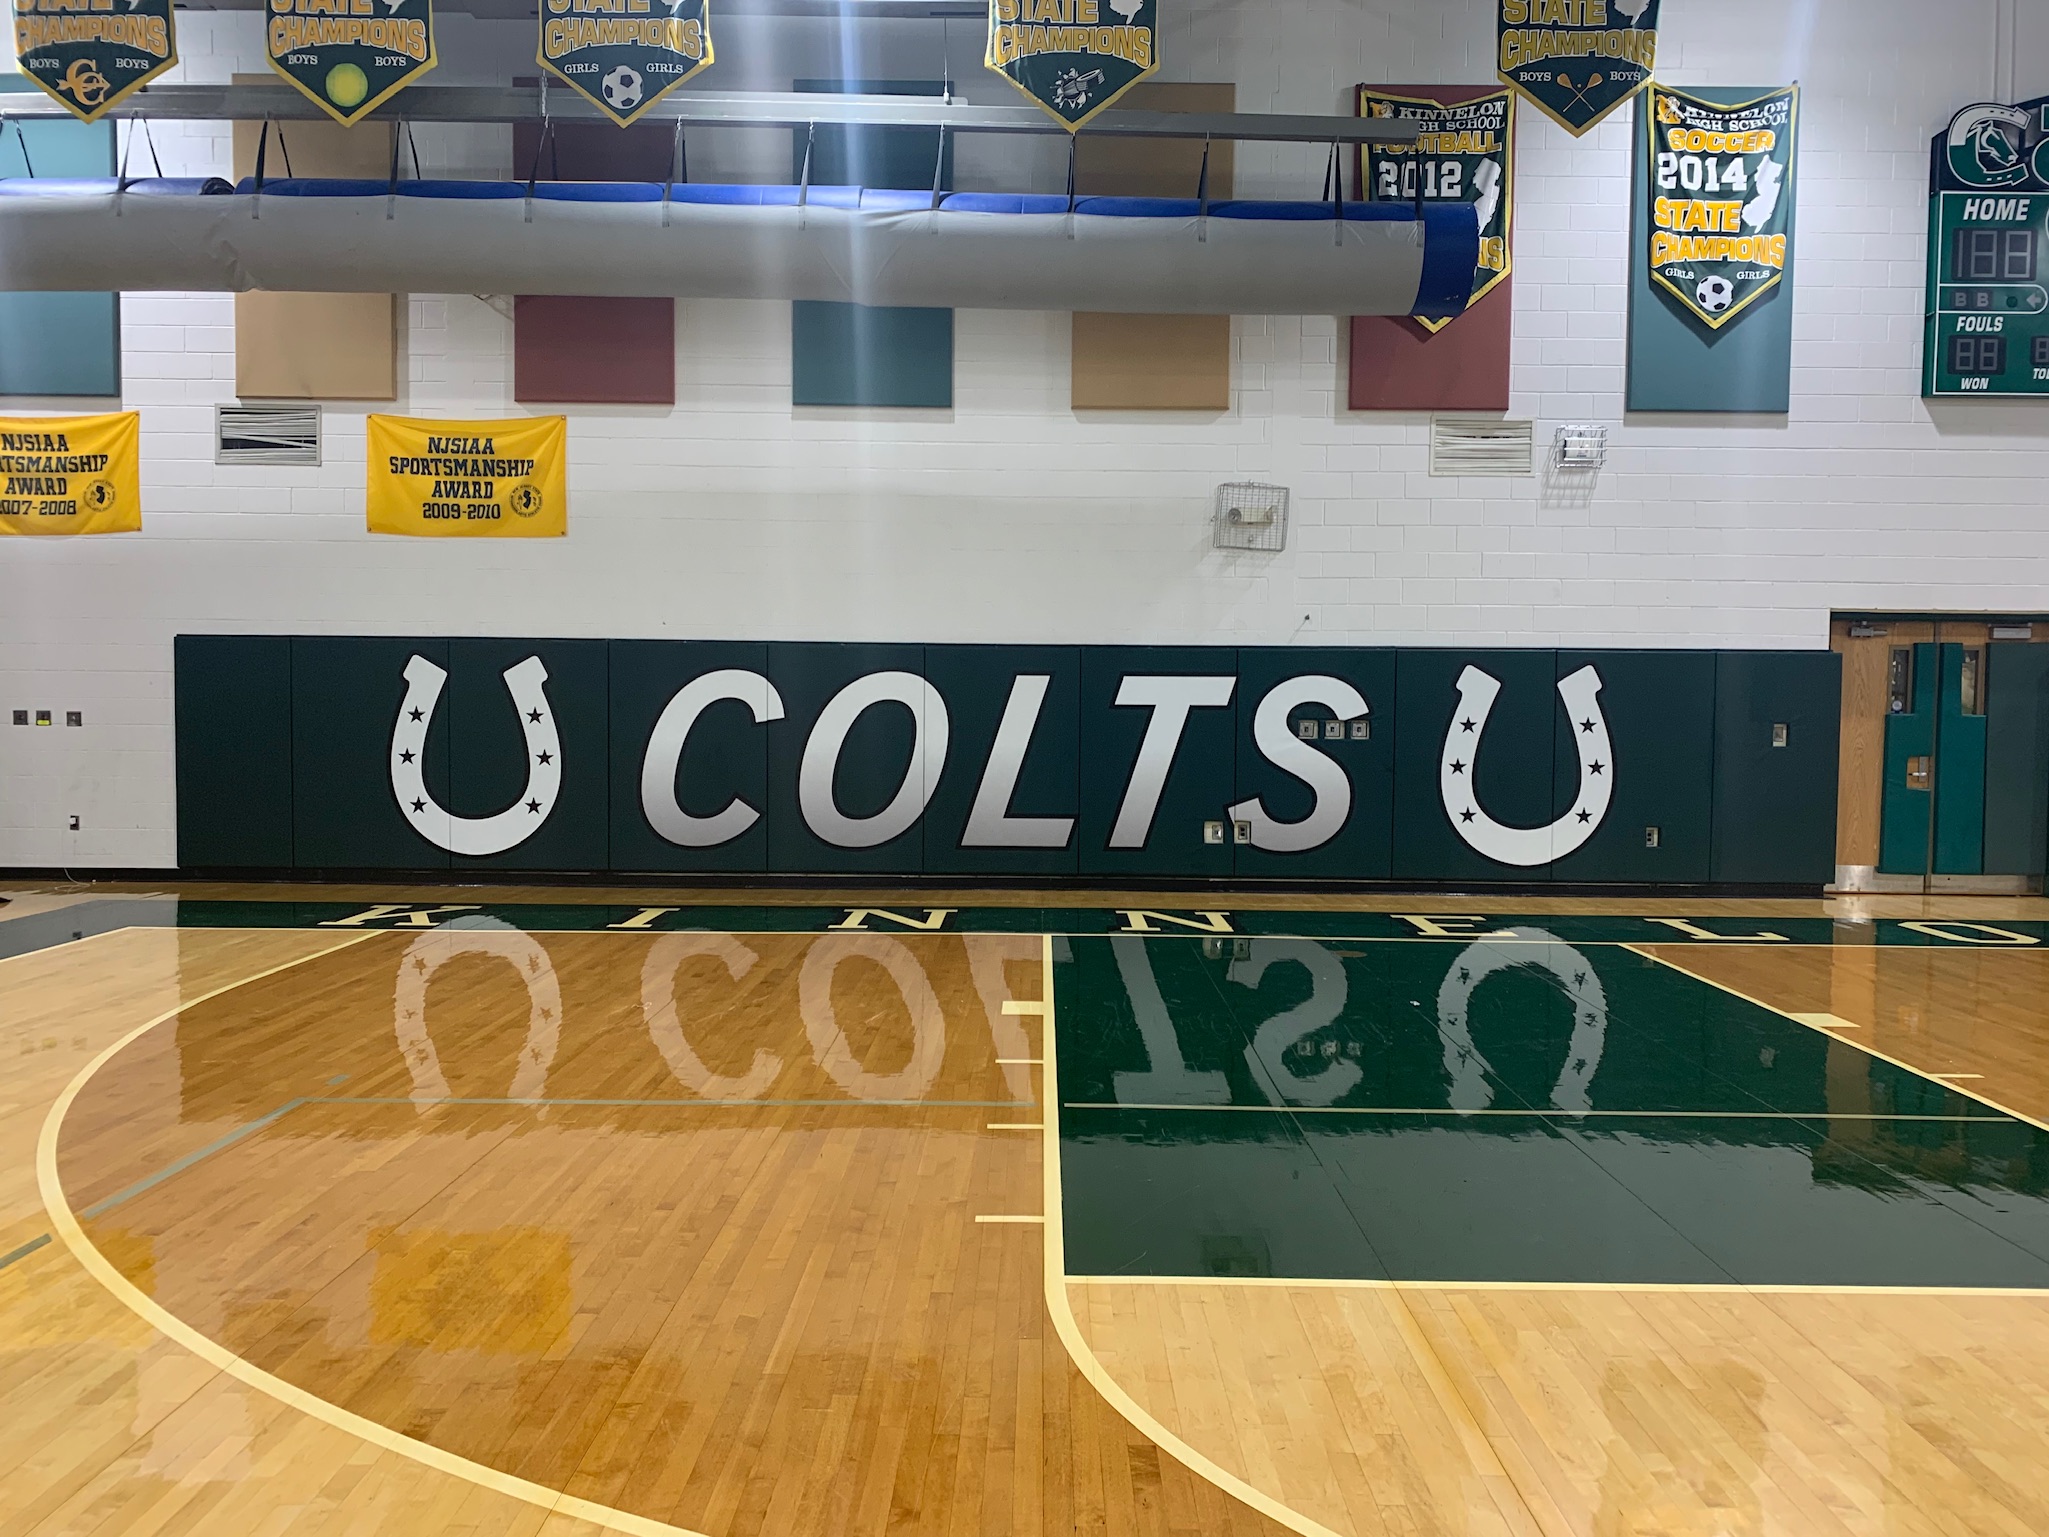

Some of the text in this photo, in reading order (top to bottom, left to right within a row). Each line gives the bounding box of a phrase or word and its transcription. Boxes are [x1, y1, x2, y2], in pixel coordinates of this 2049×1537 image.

[15, 14, 169, 58] CHAMPIONS
[269, 15, 427, 62] CHAMPIONS
[545, 17, 702, 59] CHAMPIONS
[994, 24, 1151, 69] CHAMPIONS
[1500, 28, 1657, 72] CHAMPIONS
[29, 57, 149, 70] BOYS BOYS
[288, 54, 407, 67] BOYS BOYS
[564, 62, 683, 74] GIRLS GIRLS
[1519, 71, 1641, 82] BOYS BOYS
[1398, 101, 1506, 120] KINNELON
[1419, 116, 1505, 132] GH SCHOOL
[1728, 111, 1788, 132] SCHOOL
[1668, 128, 1776, 153] SOCCER
[1378, 161, 1462, 198] 2012
[1657, 152, 1748, 192] 2014
[1654, 195, 1743, 233] STATE
[1963, 198, 2031, 221] HOME
[1650, 231, 1787, 270] CHAMPIONS
[1665, 267, 1770, 280] GIRLS GIRLS
[1956, 316, 2004, 332] FOULS
[1961, 377, 1989, 390] WON
[1, 433, 69, 452] NJSIAA
[427, 437, 495, 454] NJSIAA
[0, 454, 108, 473] TSMANSHIP
[389, 456, 534, 477] SPORTSMANSHIP
[4, 477, 67, 495] AWARD
[431, 480, 494, 499] AWARD
[0, 499, 77, 515] 007-2008
[422, 502, 501, 519] 2009-2010
[641, 668, 1370, 852] COLTS
